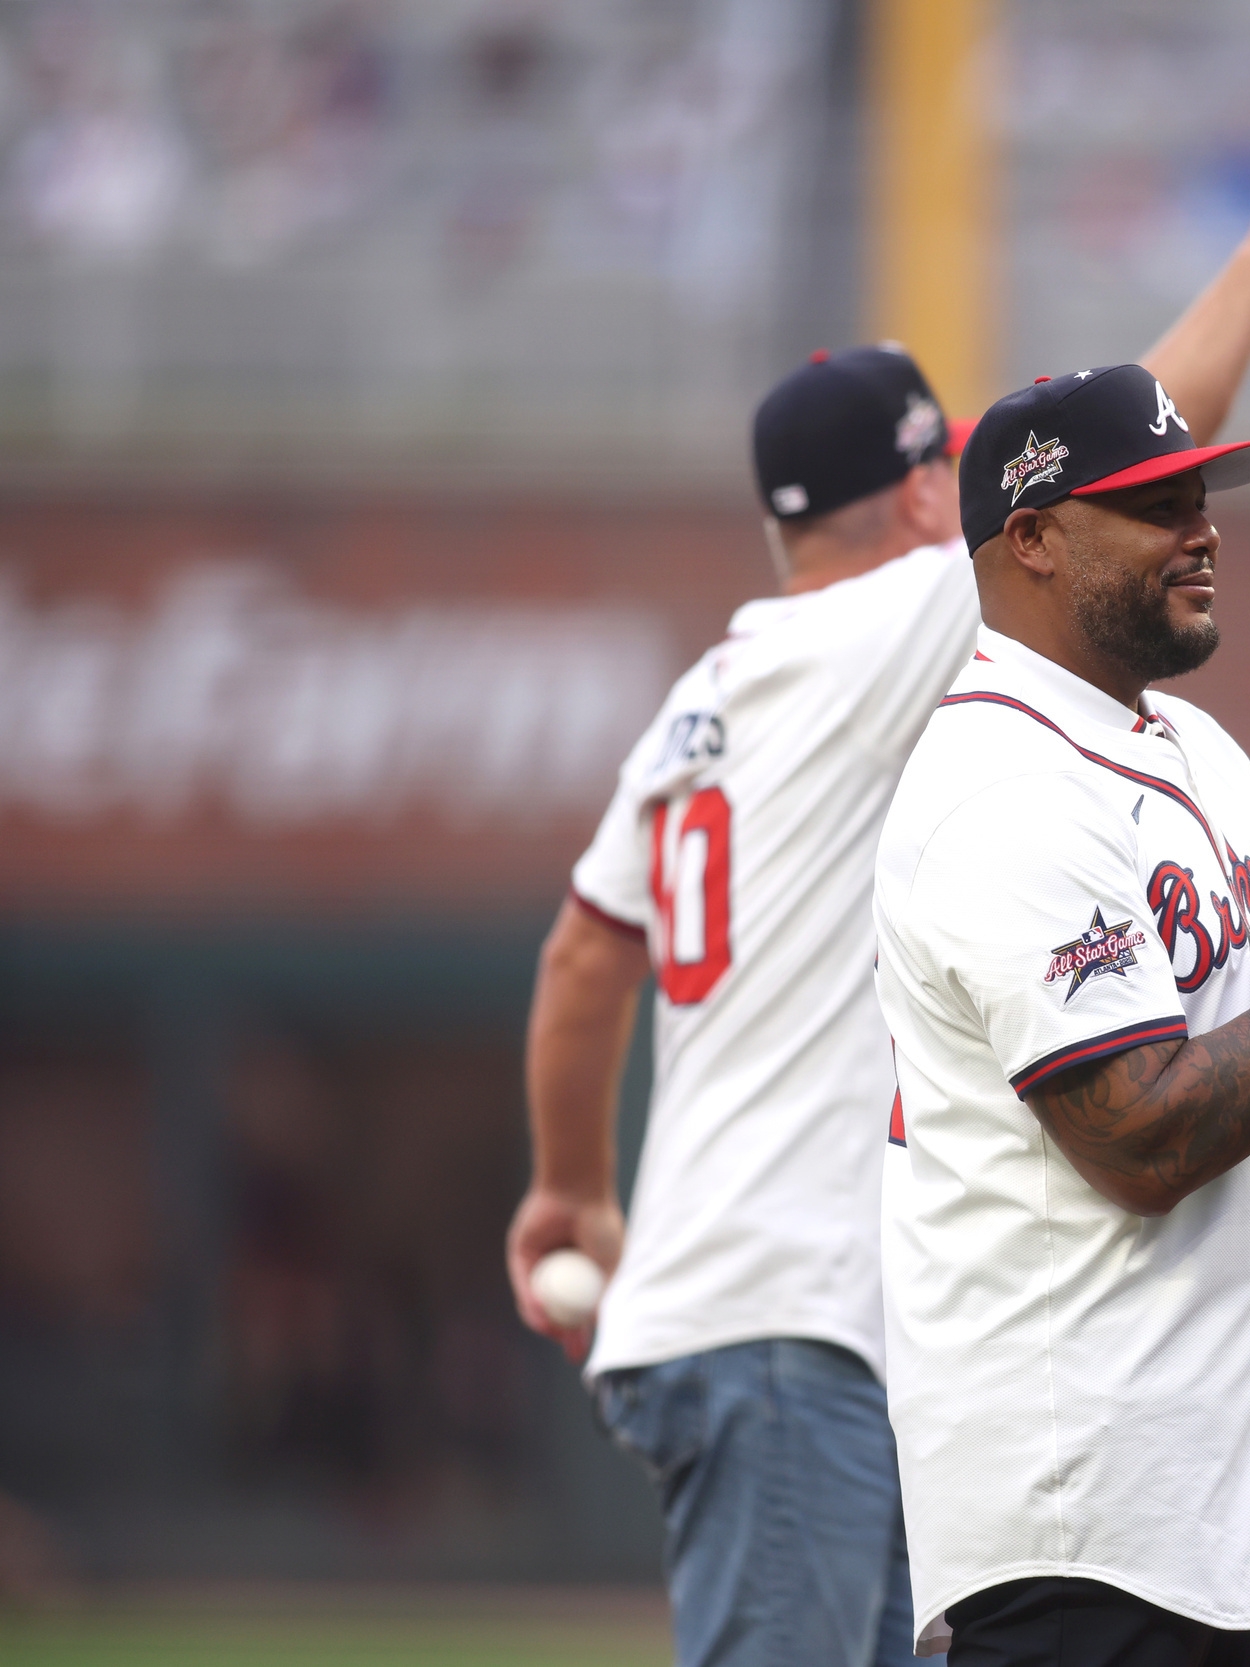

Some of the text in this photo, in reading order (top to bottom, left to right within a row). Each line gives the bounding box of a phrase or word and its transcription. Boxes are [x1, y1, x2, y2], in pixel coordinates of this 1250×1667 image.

[1149, 380, 1189, 436] A
[1044, 931, 1146, 982] All Star Game
[1093, 962, 1118, 976] ATLANTA
